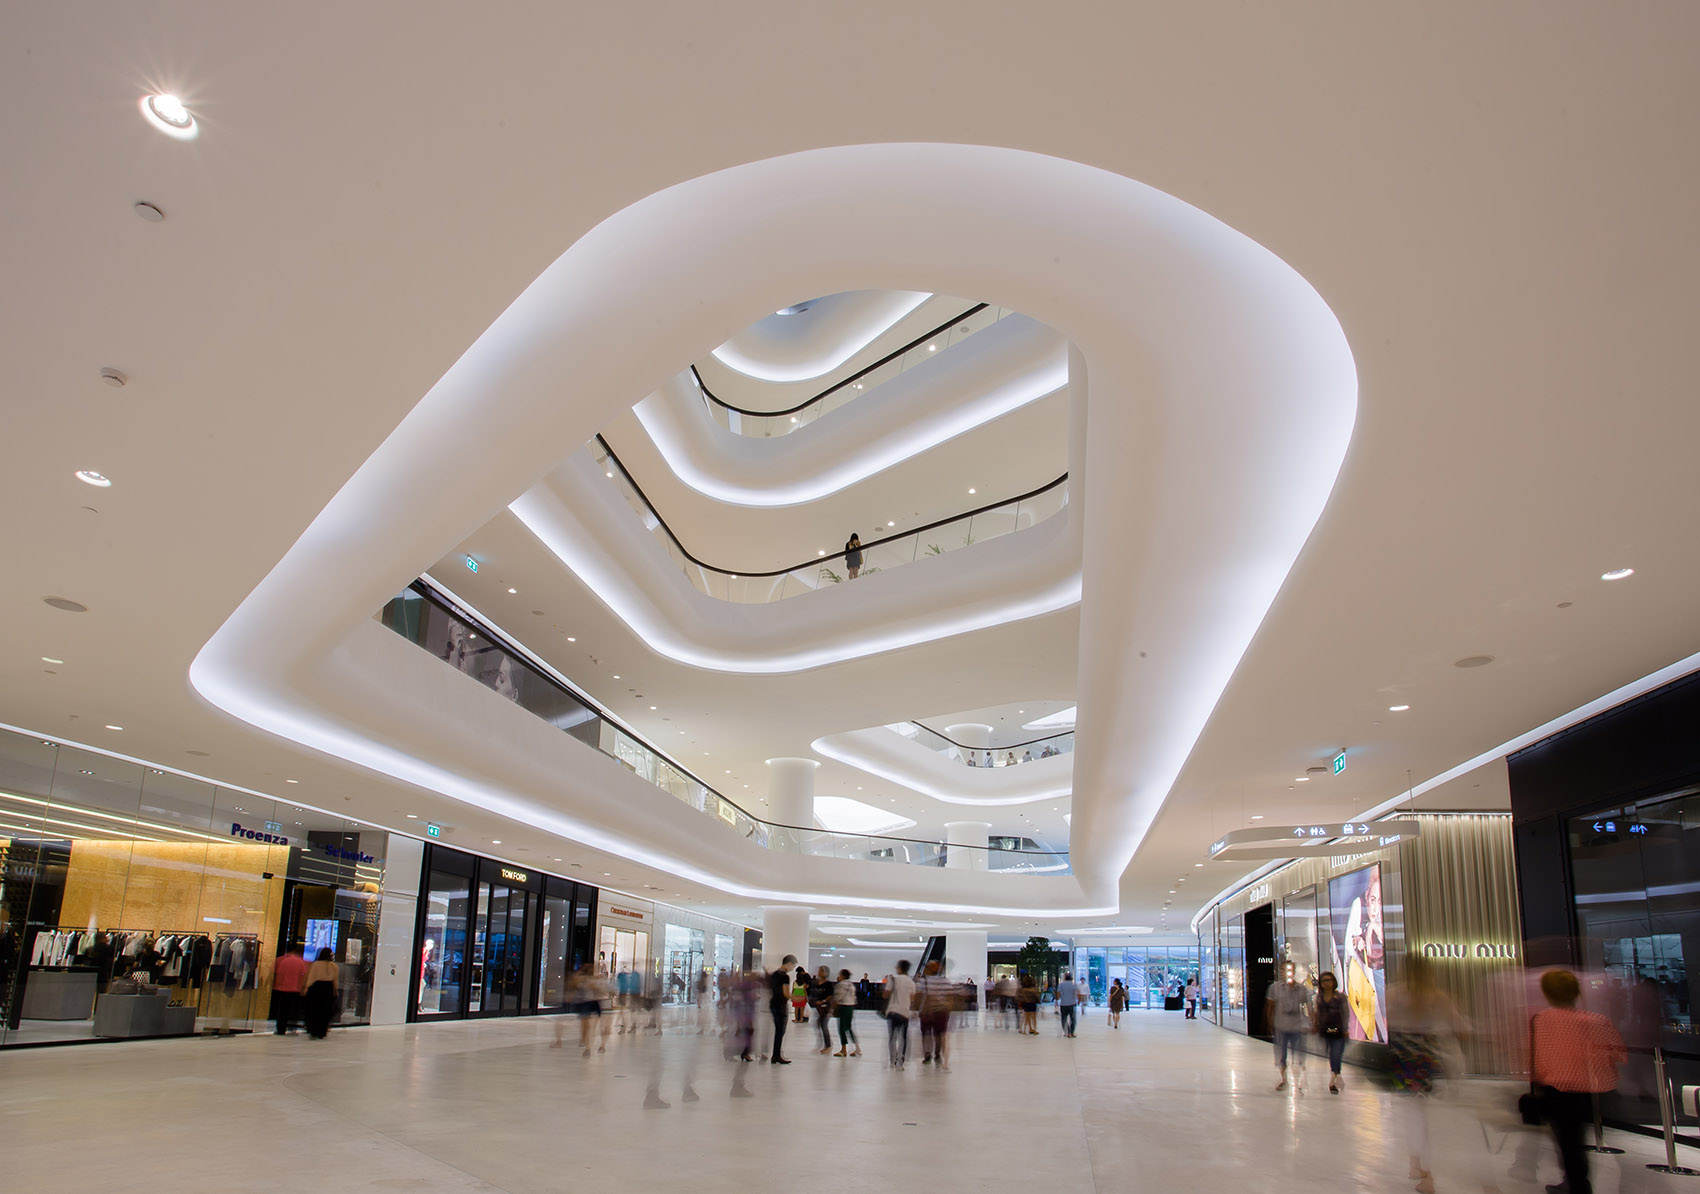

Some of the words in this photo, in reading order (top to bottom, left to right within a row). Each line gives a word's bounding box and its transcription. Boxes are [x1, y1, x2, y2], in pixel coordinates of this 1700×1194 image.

[231, 823, 289, 846] Proenza
[325, 844, 375, 864] Schouler
[501, 868, 513, 879] TOM
[513, 871, 527, 882] FORD
